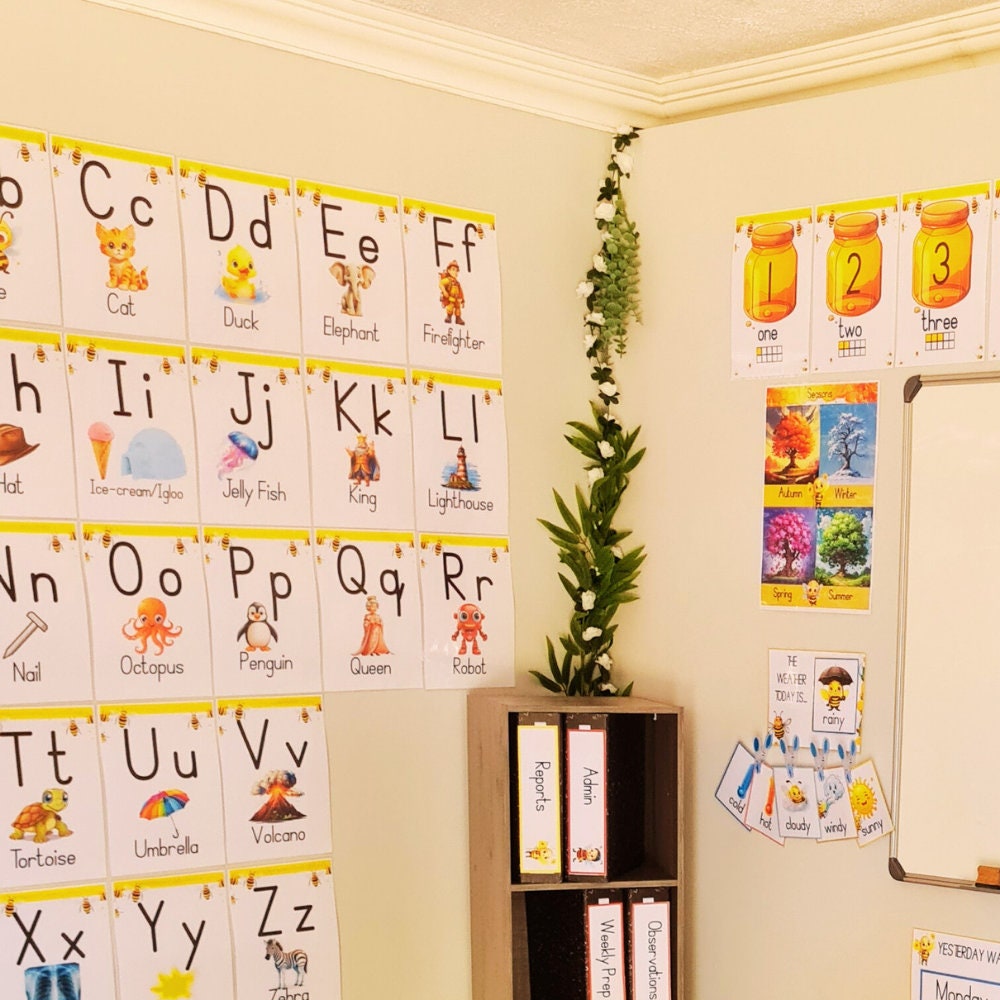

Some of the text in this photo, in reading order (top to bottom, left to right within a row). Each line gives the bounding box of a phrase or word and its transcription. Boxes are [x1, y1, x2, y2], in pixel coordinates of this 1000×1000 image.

[80, 160, 153, 227] Cc
[204, 184, 273, 250] Dd
[322, 203, 379, 264] Ee
[433, 217, 478, 272] Ff
[846, 252, 860, 295] 2
[932, 242, 949, 285] 3
[768, 262, 772, 302] 1
[107, 293, 136, 317] Cat
[224, 307, 259, 331] Duck
[323, 316, 379, 345] Elephant
[838, 318, 862, 338] two
[922, 310, 958, 331] three
[423, 324, 485, 354] Firefighter
[758, 328, 777, 341] one
[230, 372, 273, 450] Jj
[335, 380, 392, 437] Kk
[222, 478, 287, 506] Jelly Fish
[349, 486, 377, 512] King
[428, 489, 494, 513] Lighthouse
[779, 487, 802, 498] Autumn
[835, 488, 857, 499] Winter
[109, 541, 182, 596] Oo
[337, 544, 404, 616] Qq
[443, 551, 493, 601] Rr
[229, 546, 292, 621] Pp
[773, 587, 792, 602] Spring
[828, 590, 853, 601] Summer
[13, 663, 41, 682] Nail
[121, 655, 184, 677] Octopus
[239, 652, 293, 677] Penguin
[350, 657, 392, 676] Queen
[453, 657, 486, 675] Robot
[777, 674, 807, 685] WEATHER
[775, 690, 795, 702] TODAY
[823, 713, 845, 731] rainy
[124, 728, 198, 780] Uu
[237, 719, 308, 769] Vv
[534, 761, 551, 812] Reports
[583, 766, 599, 806] Admin
[728, 797, 745, 814] cold
[760, 813, 772, 831] hot
[786, 816, 811, 835] cloudy
[824, 819, 847, 837] windy
[862, 819, 883, 836] sunny
[251, 826, 305, 844] Volcano
[10, 848, 76, 868] Tortoise
[134, 839, 199, 859] Umbrella
[254, 885, 315, 937] Zz
[13, 909, 85, 965] Xx
[138, 900, 205, 970] Yy
[595, 919, 616, 998] Weekly Prep
[647, 920, 663, 1000] Observations
[938, 942, 984, 961] YESTERDAY
